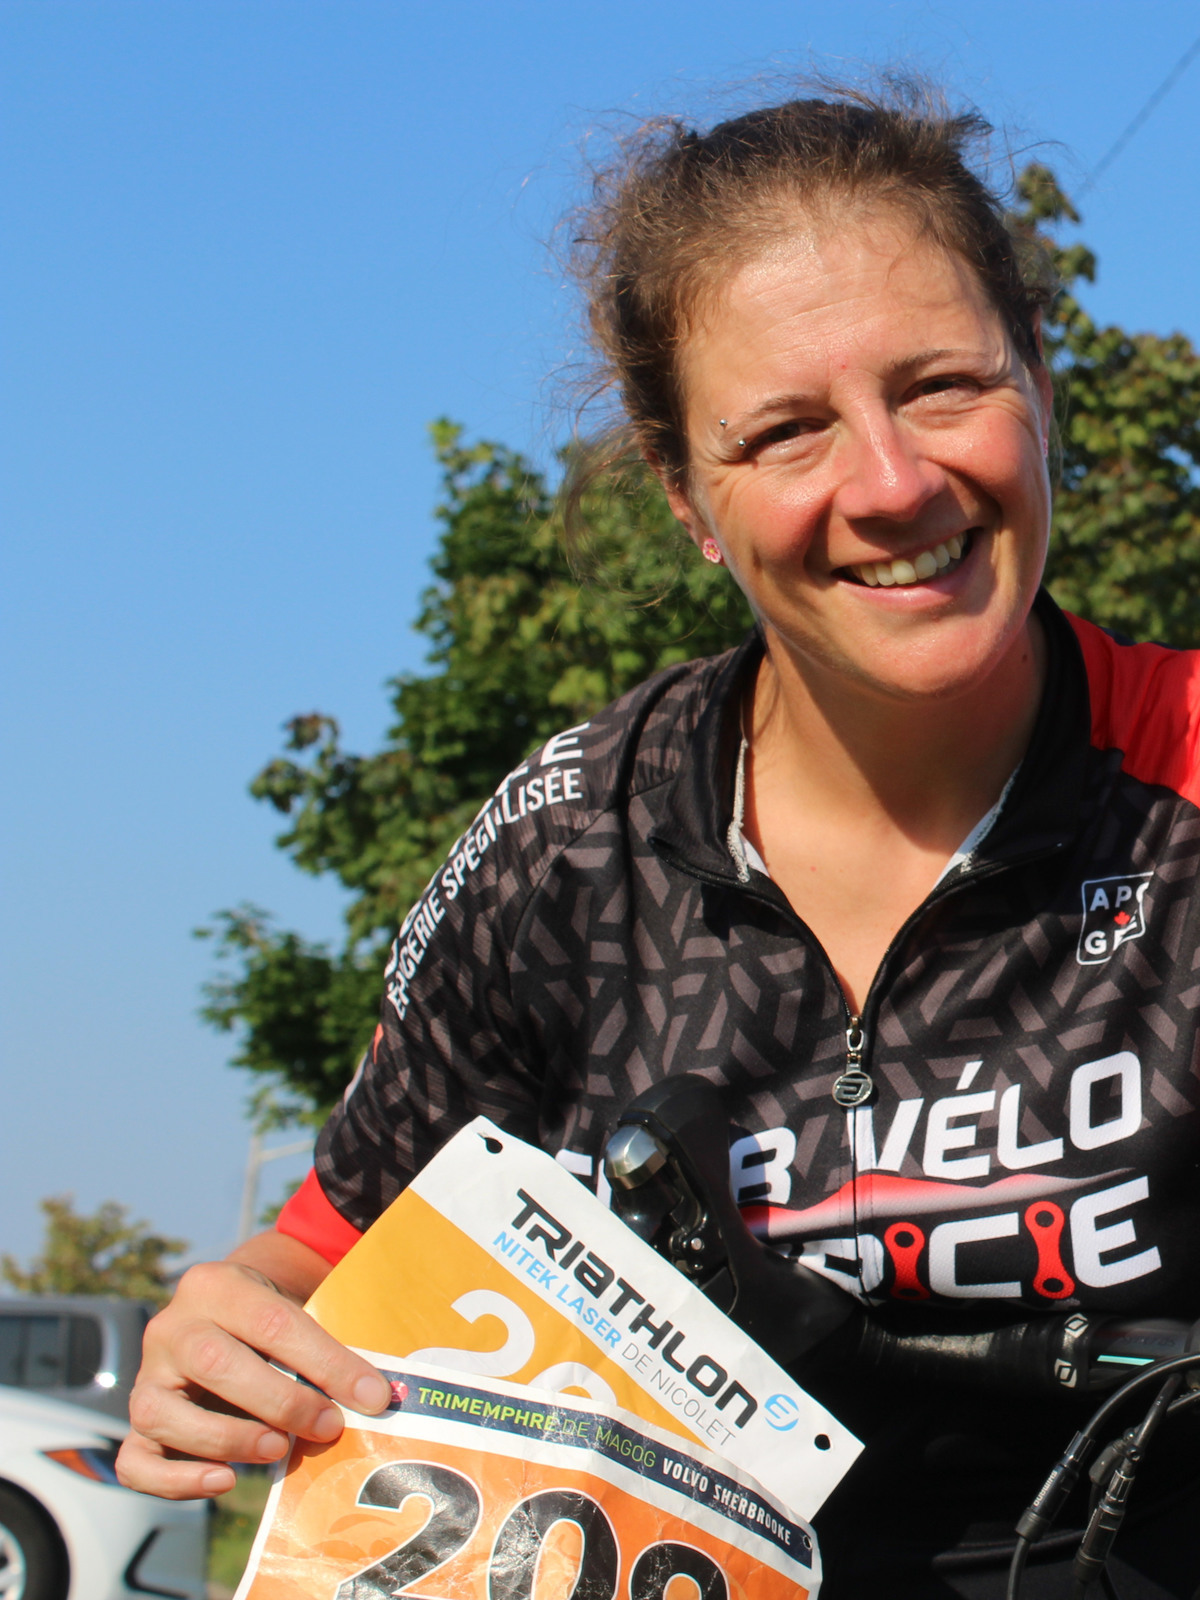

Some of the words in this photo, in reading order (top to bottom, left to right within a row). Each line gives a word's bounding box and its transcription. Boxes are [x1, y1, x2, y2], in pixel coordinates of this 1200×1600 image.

[845, 1051, 1142, 1180] VÉLO
[492, 1231, 559, 1290] NITEK
[556, 1283, 623, 1348] LASER
[622, 1342, 654, 1375] DE
[649, 1368, 736, 1446] NICOLET
[511, 1188, 758, 1429] TRIATHLON
[417, 1387, 558, 1432] TRIMEMPHRE
[560, 1418, 589, 1438] DE
[595, 1426, 657, 1468] MAGOG
[662, 1457, 709, 1493] VOLVO
[713, 1483, 792, 1546] SHERBROOKE
